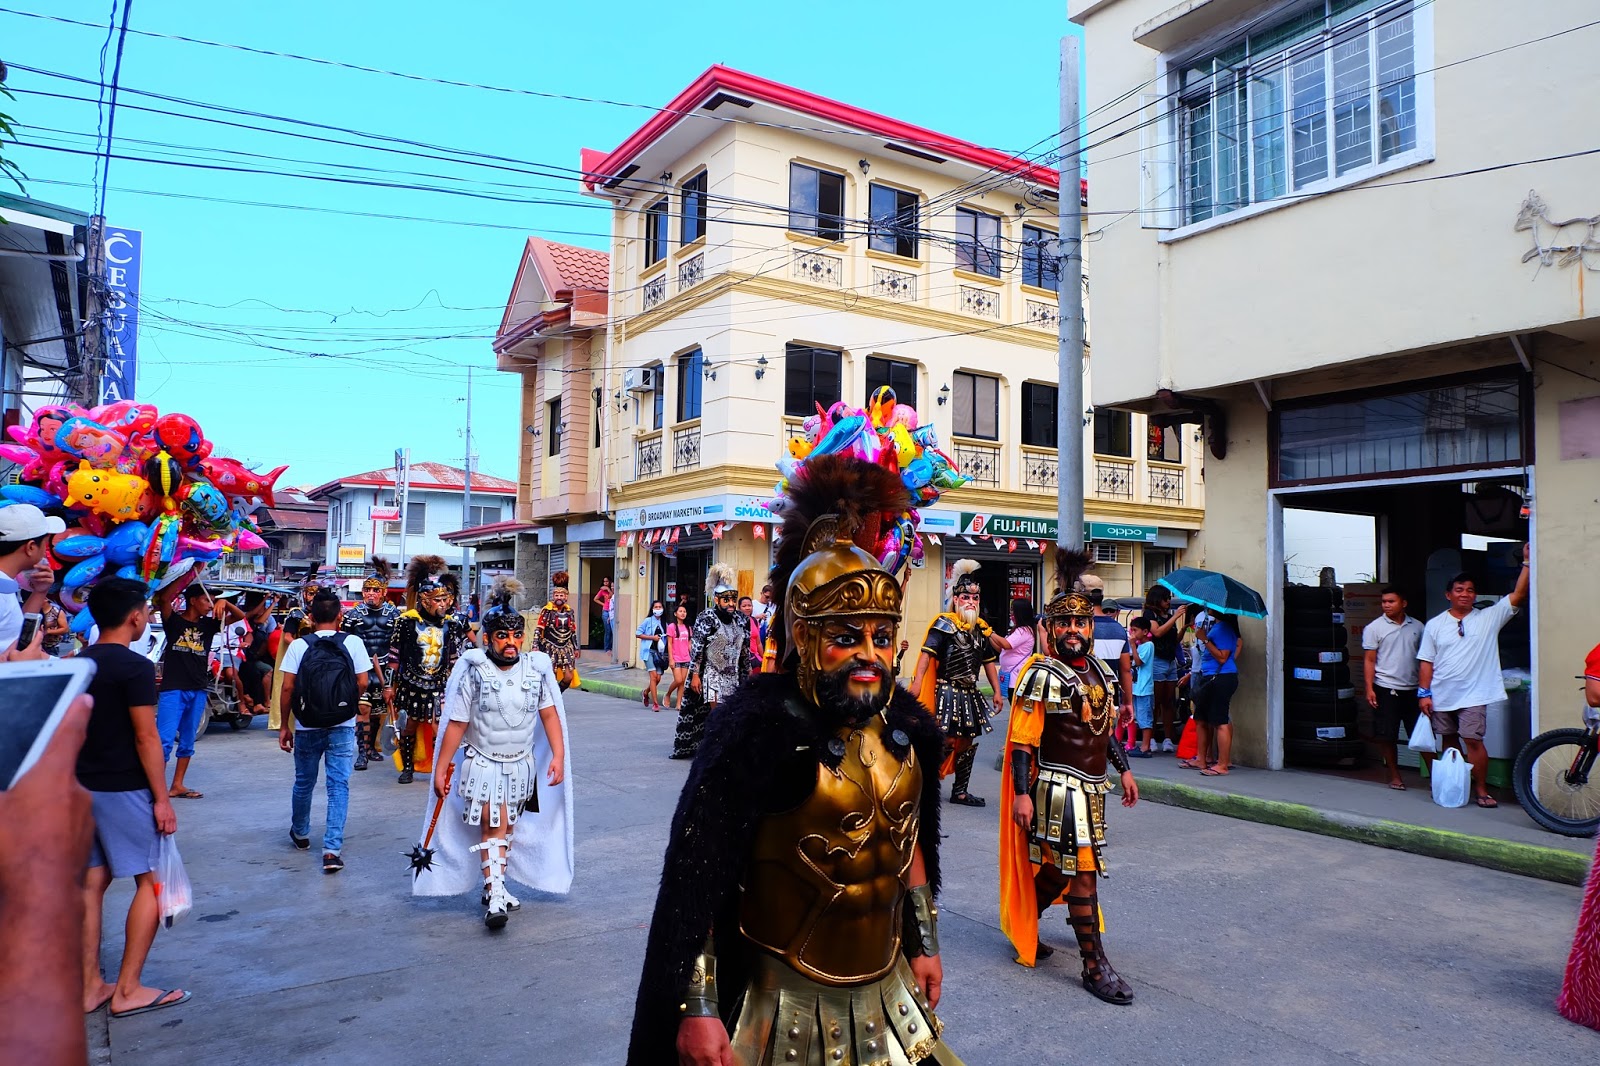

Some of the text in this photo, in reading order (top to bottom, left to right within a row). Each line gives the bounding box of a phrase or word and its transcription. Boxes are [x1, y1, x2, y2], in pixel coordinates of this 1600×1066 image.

[647, 510, 672, 521] BROADWAY
[673, 506, 702, 518] MARKETING
[735, 506, 773, 518] SMART
[617, 518, 633, 528] SMART
